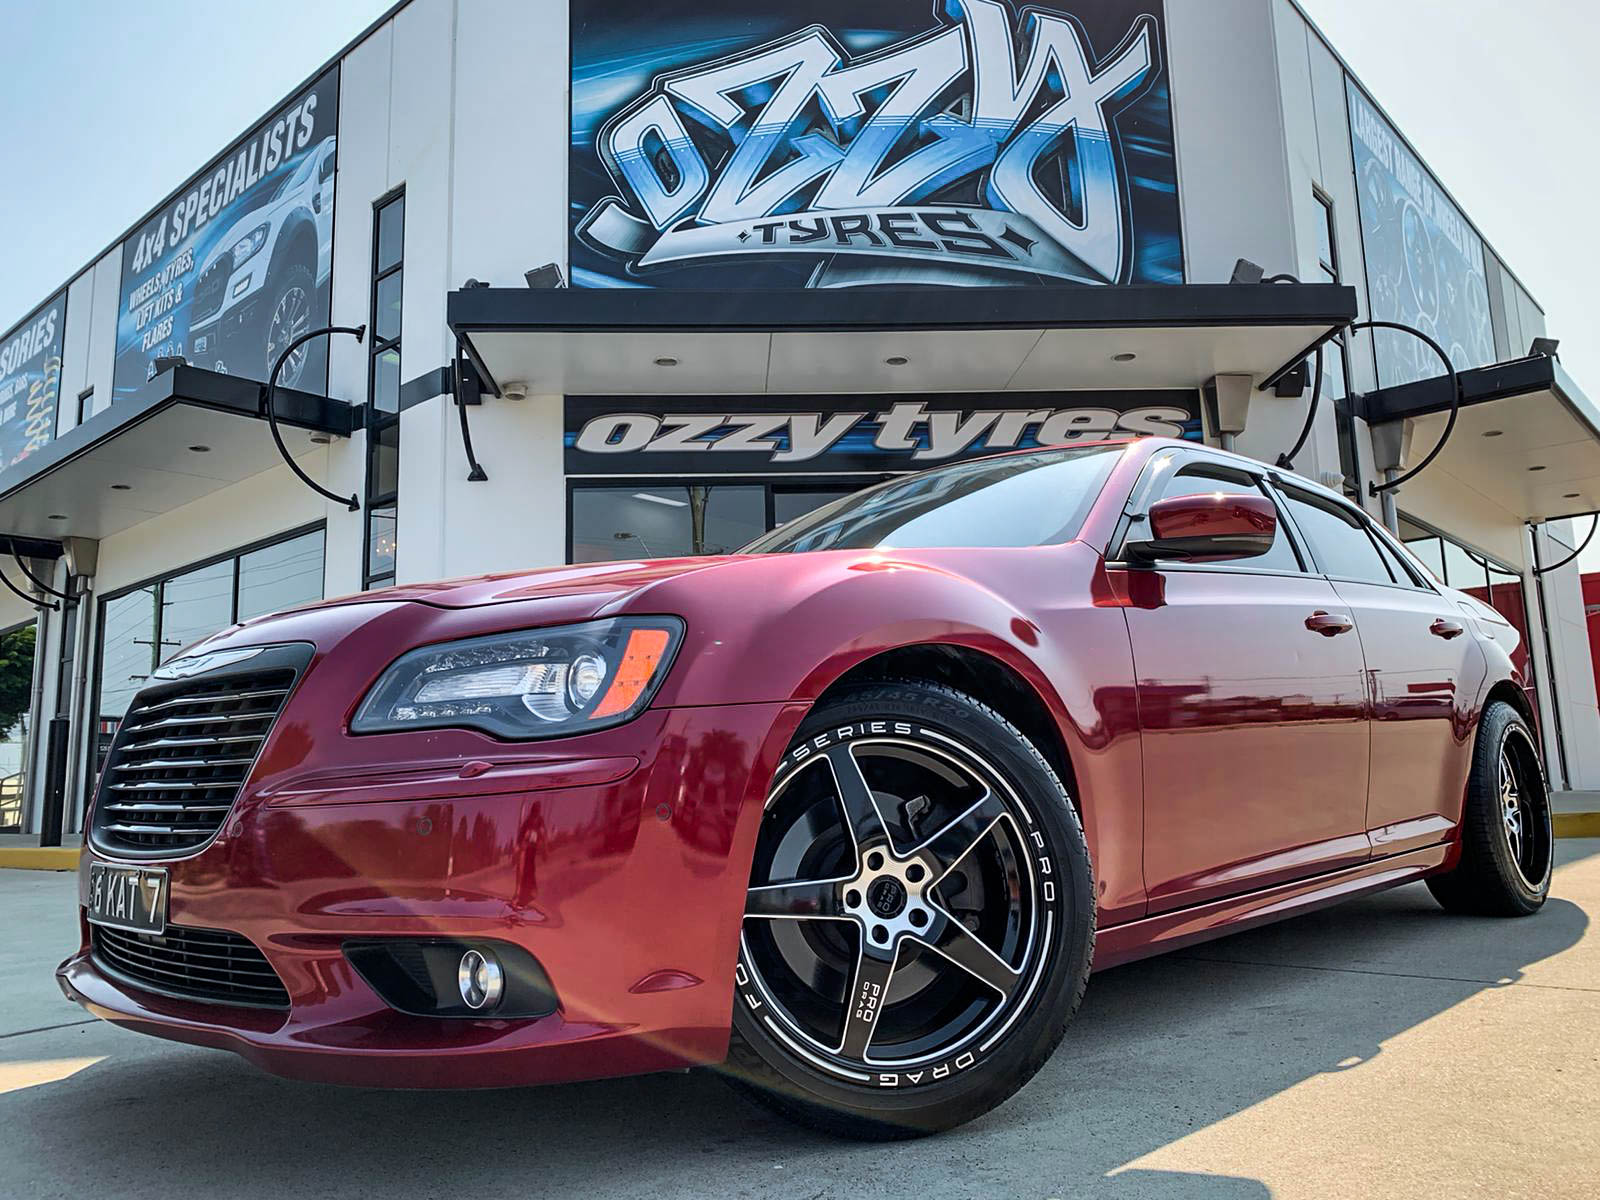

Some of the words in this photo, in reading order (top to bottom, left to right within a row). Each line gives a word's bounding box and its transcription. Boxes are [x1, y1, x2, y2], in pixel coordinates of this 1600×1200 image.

[1352, 94, 1393, 174] LARGEST
[170, 94, 318, 248] SPECIALISTS
[753, 210, 1016, 258] TYRES
[136, 302, 154, 331] LIFT
[154, 289, 175, 317] KITS
[175, 282, 184, 305] &
[142, 315, 174, 352] FLARES
[574, 409, 869, 461] ozzy
[880, 402, 1192, 459] tyres
[792, 721, 912, 761] SERIES
[1030, 831, 1056, 901] PRO
[856, 981, 870, 1018] DRAG
[863, 983, 881, 1023] PRO
[879, 1052, 975, 1087] DRAG
